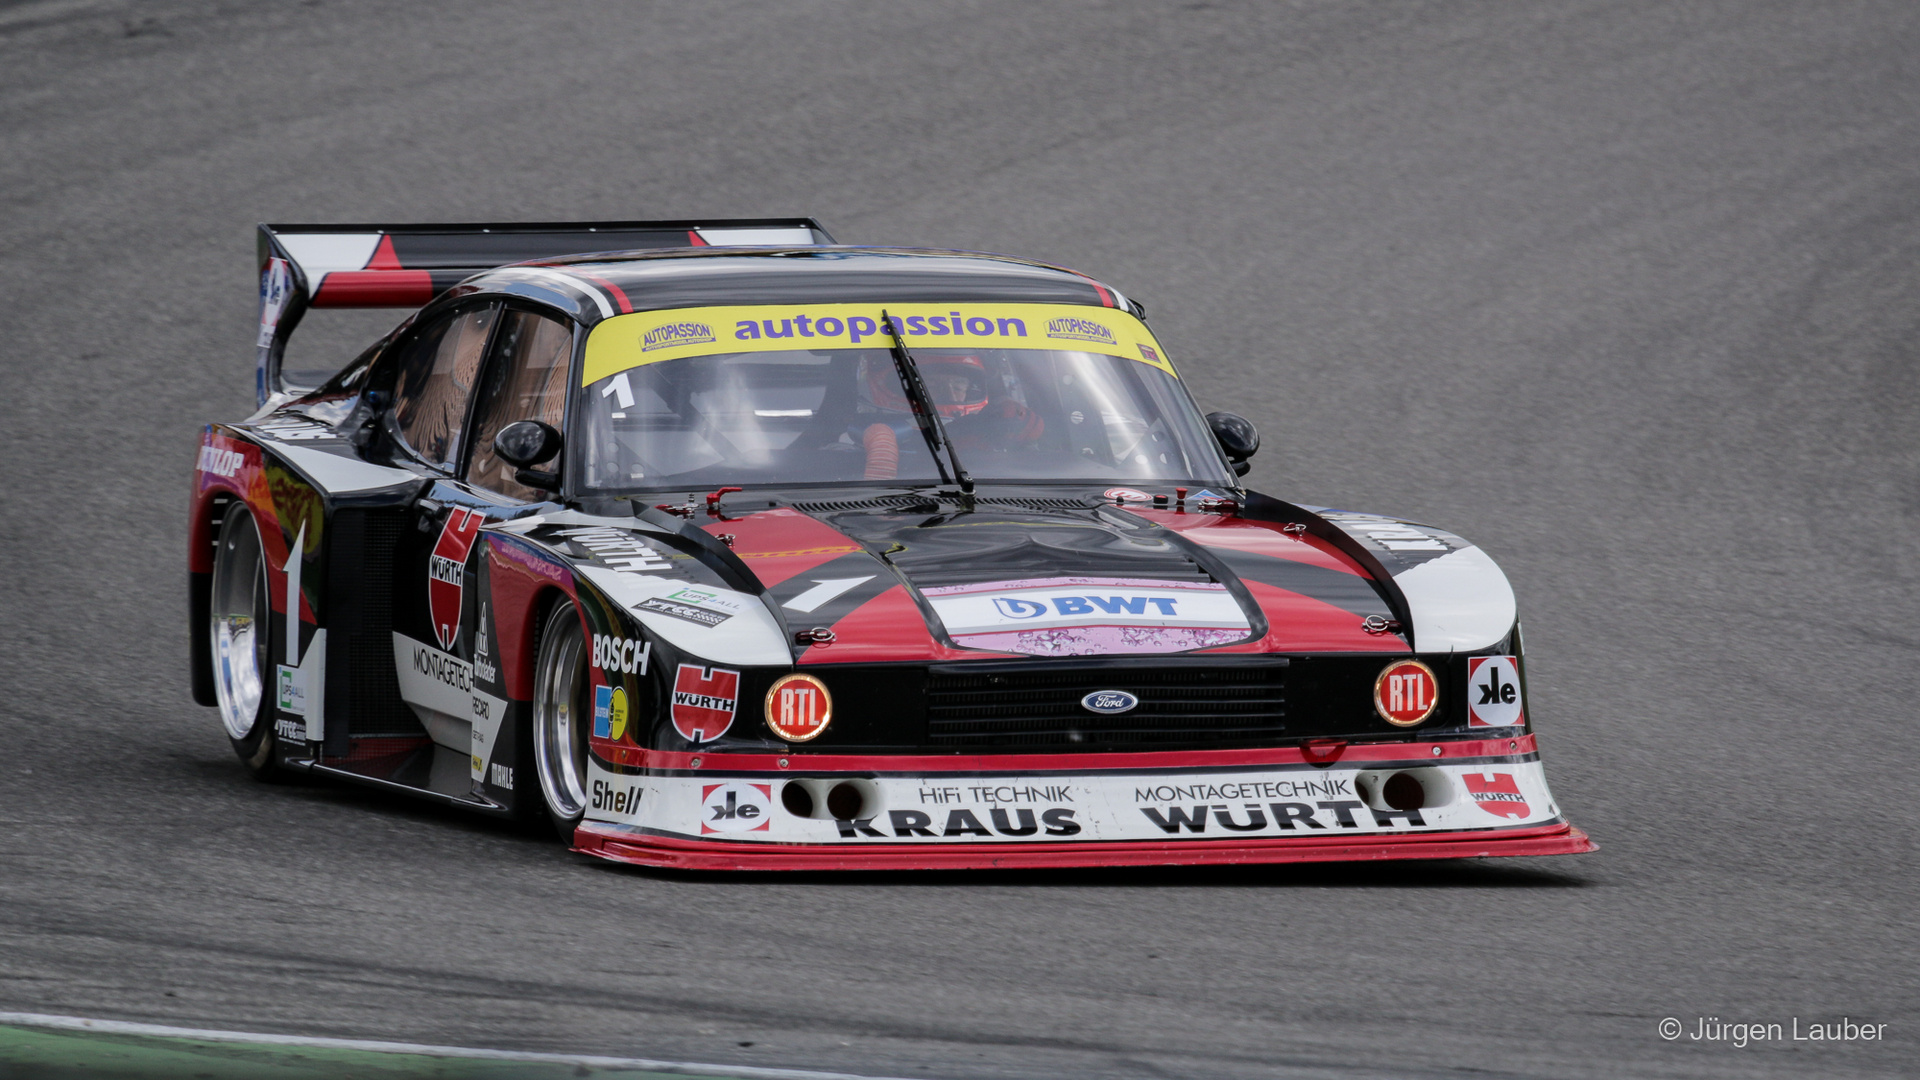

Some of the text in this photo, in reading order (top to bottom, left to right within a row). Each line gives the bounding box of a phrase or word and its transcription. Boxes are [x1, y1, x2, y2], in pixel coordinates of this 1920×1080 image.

[643, 323, 711, 346] AUTOPASSION
[735, 311, 1027, 343] autopassion
[1048, 318, 1113, 339] AUTOPASSION
[602, 373, 635, 409] 1
[431, 556, 464, 586] WÜRTH
[283, 518, 306, 666] 1
[781, 575, 877, 613] 1
[1051, 596, 1178, 616] BWT
[592, 633, 651, 676] BOSCH
[674, 691, 735, 712] WÜRTH
[780, 688, 820, 726] RTL
[1095, 694, 1125, 708] Ford
[1389, 673, 1428, 712] RTL
[492, 762, 513, 790] MAHLE
[1135, 779, 1352, 803] MONTAGETECHNIK
[592, 779, 644, 816] Shell
[918, 785, 1074, 804] HiFi TECHNIK
[835, 808, 1082, 838] KRAUS
[1139, 800, 1428, 834] WÜRTH
